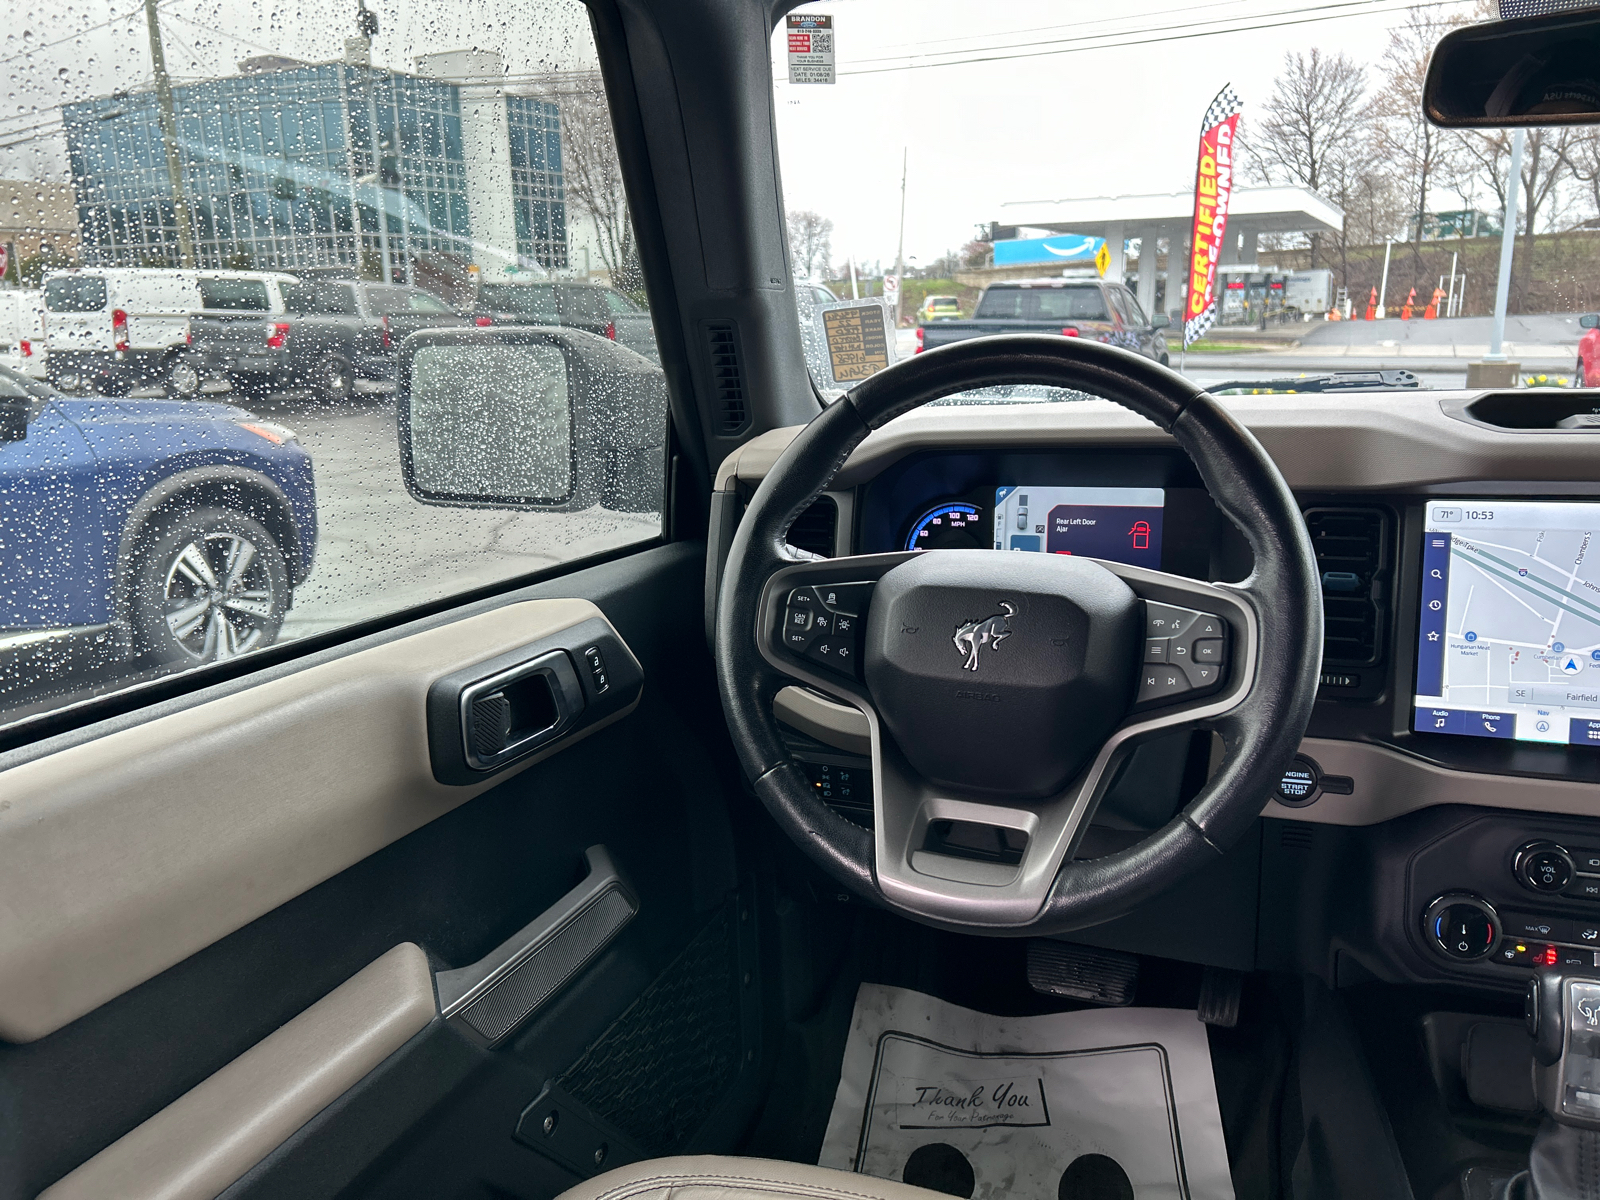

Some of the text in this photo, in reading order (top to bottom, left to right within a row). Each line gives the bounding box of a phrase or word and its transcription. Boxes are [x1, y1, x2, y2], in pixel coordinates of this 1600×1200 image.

[1191, 158, 1217, 315] CERTIFIED
[1440, 510, 1454, 519] 71°
[1466, 510, 1494, 520] 10:53
[1574, 536, 1590, 565] Chambers
[955, 690, 1001, 702] AIRBAG
[1515, 690, 1526, 698] SE
[1566, 692, 1598, 702] Fairfield
[912, 1082, 1030, 1109] Thank You
[927, 1110, 1014, 1122] For Your Patronage
